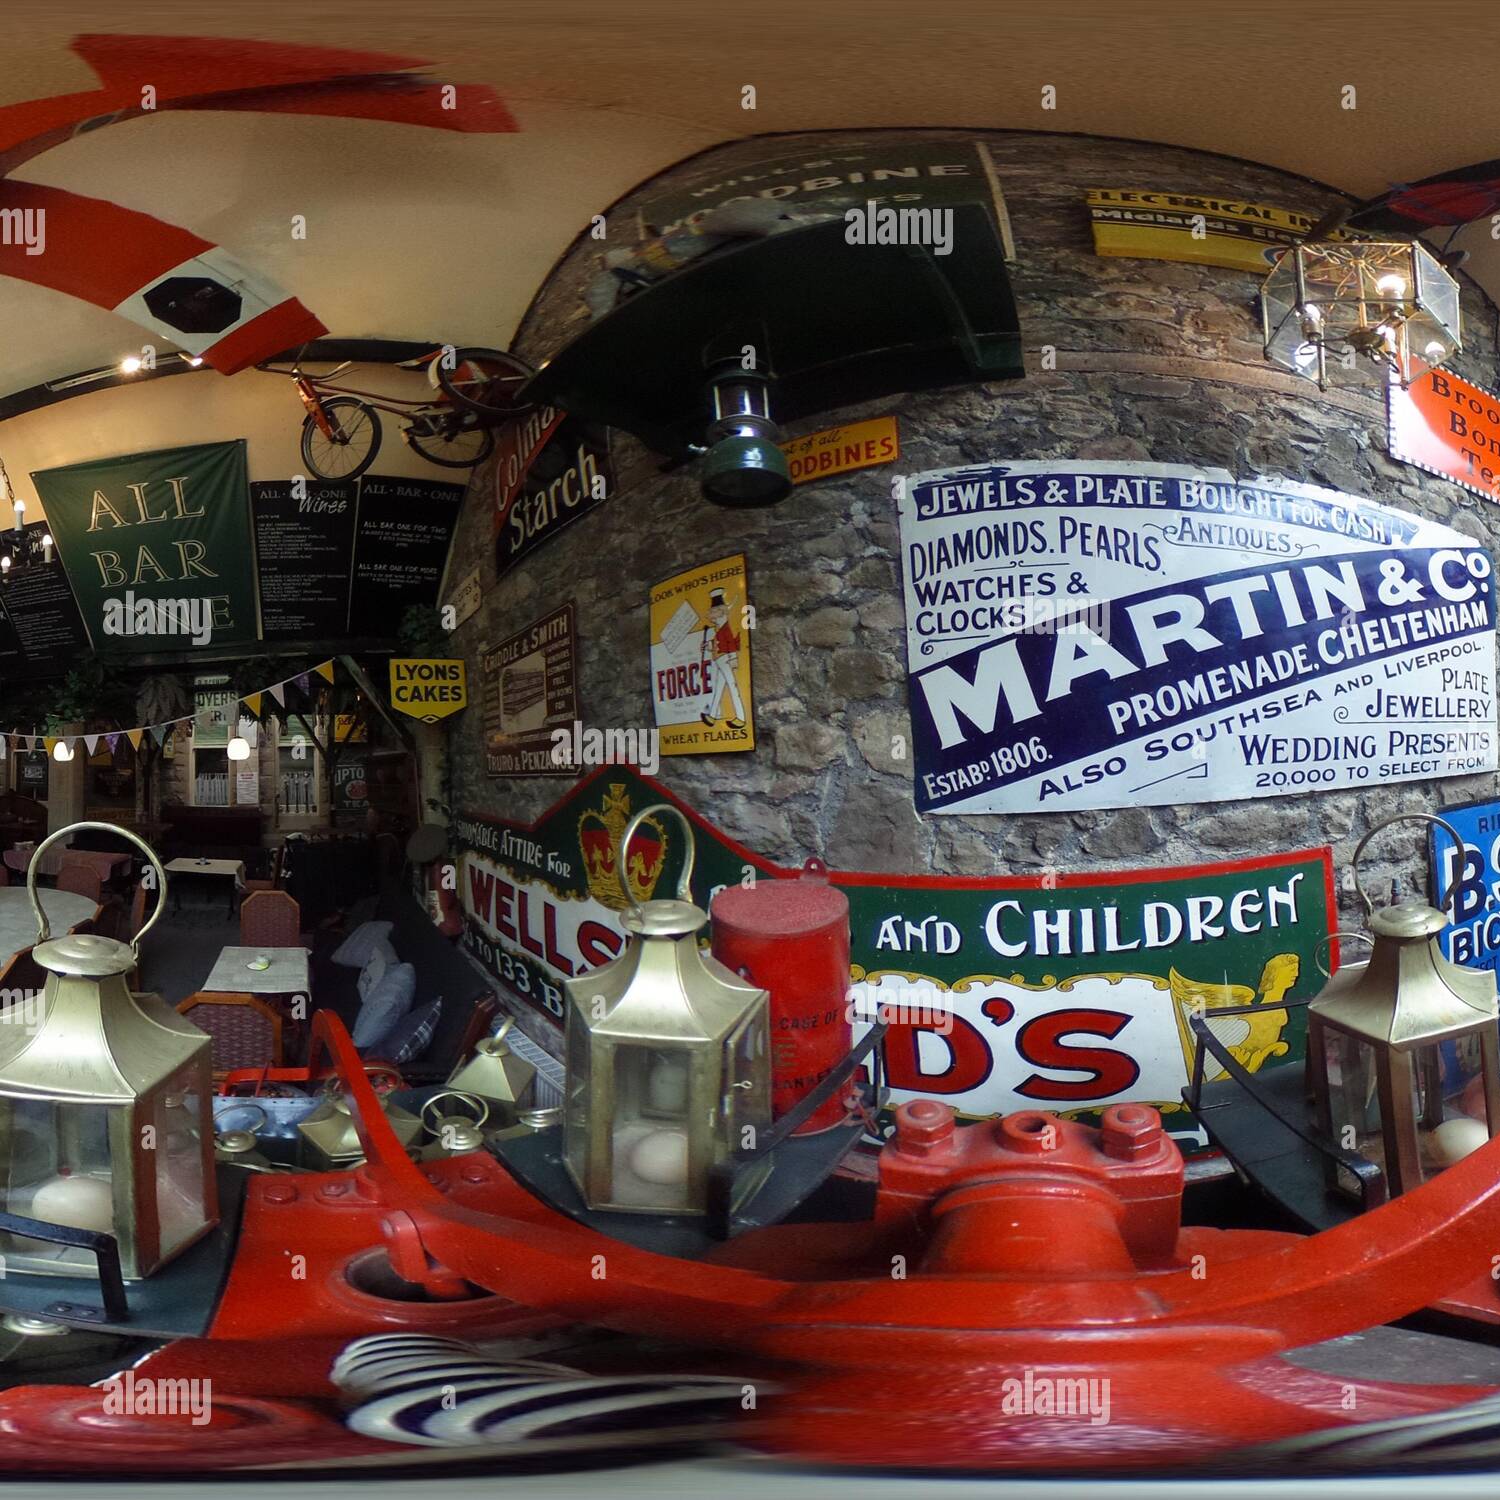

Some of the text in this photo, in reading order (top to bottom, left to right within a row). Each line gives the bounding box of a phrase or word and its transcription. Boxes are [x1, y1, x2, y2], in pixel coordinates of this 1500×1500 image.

[1086, 189, 1280, 222] ELECTRICAL
[789, 436, 894, 479] ODBINES
[84, 476, 206, 534] ALL
[298, 497, 348, 515] Wines
[363, 484, 460, 502] ALL BAR ONE
[509, 443, 600, 554] Starch
[920, 474, 1387, 543] JEWELS & PLATE BOUGHT FOR CASH
[1178, 516, 1292, 553] ANTIQUES
[89, 538, 220, 589] BAR
[675, 565, 744, 594] WHO'S HERE
[914, 571, 1091, 606] WATCHES &
[531, 613, 568, 650] SMITH
[1318, 600, 1490, 665] CHELTENHAM
[918, 554, 1367, 750] MARTIN
[1378, 558, 1427, 603] &
[395, 663, 461, 682] LYONS
[656, 659, 713, 702] FORCE
[1441, 668, 1491, 695] PLATE
[394, 684, 464, 703] CAKES
[1365, 689, 1492, 720] JEWELLERY
[662, 729, 749, 746] WHEAT FLAKES
[1038, 758, 1128, 802] ALSO
[1144, 689, 1321, 761] SOUTHSEA
[1333, 673, 1375, 697] AND
[1238, 730, 1492, 766] WEDDING PRESENTS
[1343, 765, 1371, 782] TO
[1378, 761, 1442, 778] SELECT
[1447, 756, 1486, 771] FROM
[499, 828, 572, 878] ATTIRE FOR
[875, 871, 1305, 958] AND CHILDREN
